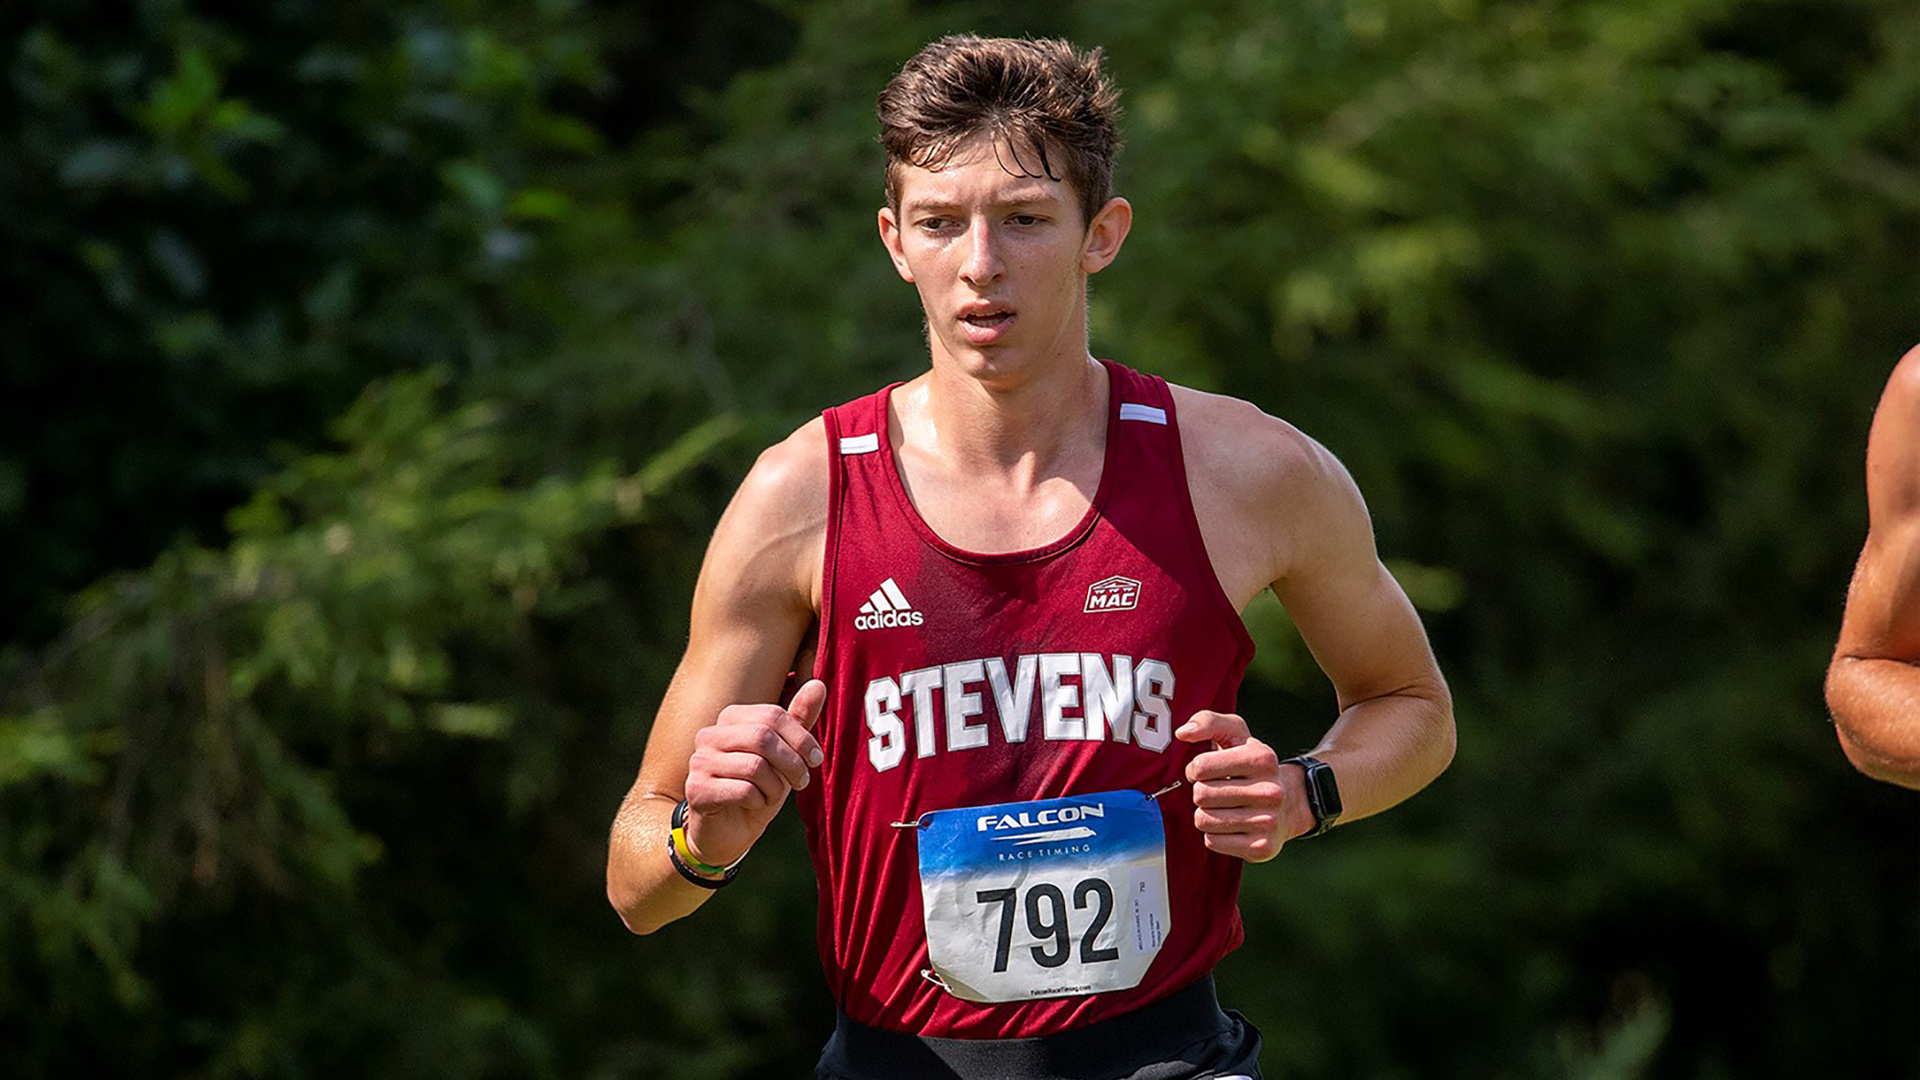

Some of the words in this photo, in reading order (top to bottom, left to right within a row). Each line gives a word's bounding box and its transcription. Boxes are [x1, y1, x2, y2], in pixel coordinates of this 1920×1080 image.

[1089, 592, 1135, 609] MAC
[854, 609, 924, 630] adidas
[864, 653, 1176, 772] STEVENS
[977, 803, 1104, 831] FALCON
[999, 850, 1033, 861] RACE
[1038, 844, 1091, 857] TIMING
[976, 878, 1119, 973] 792
